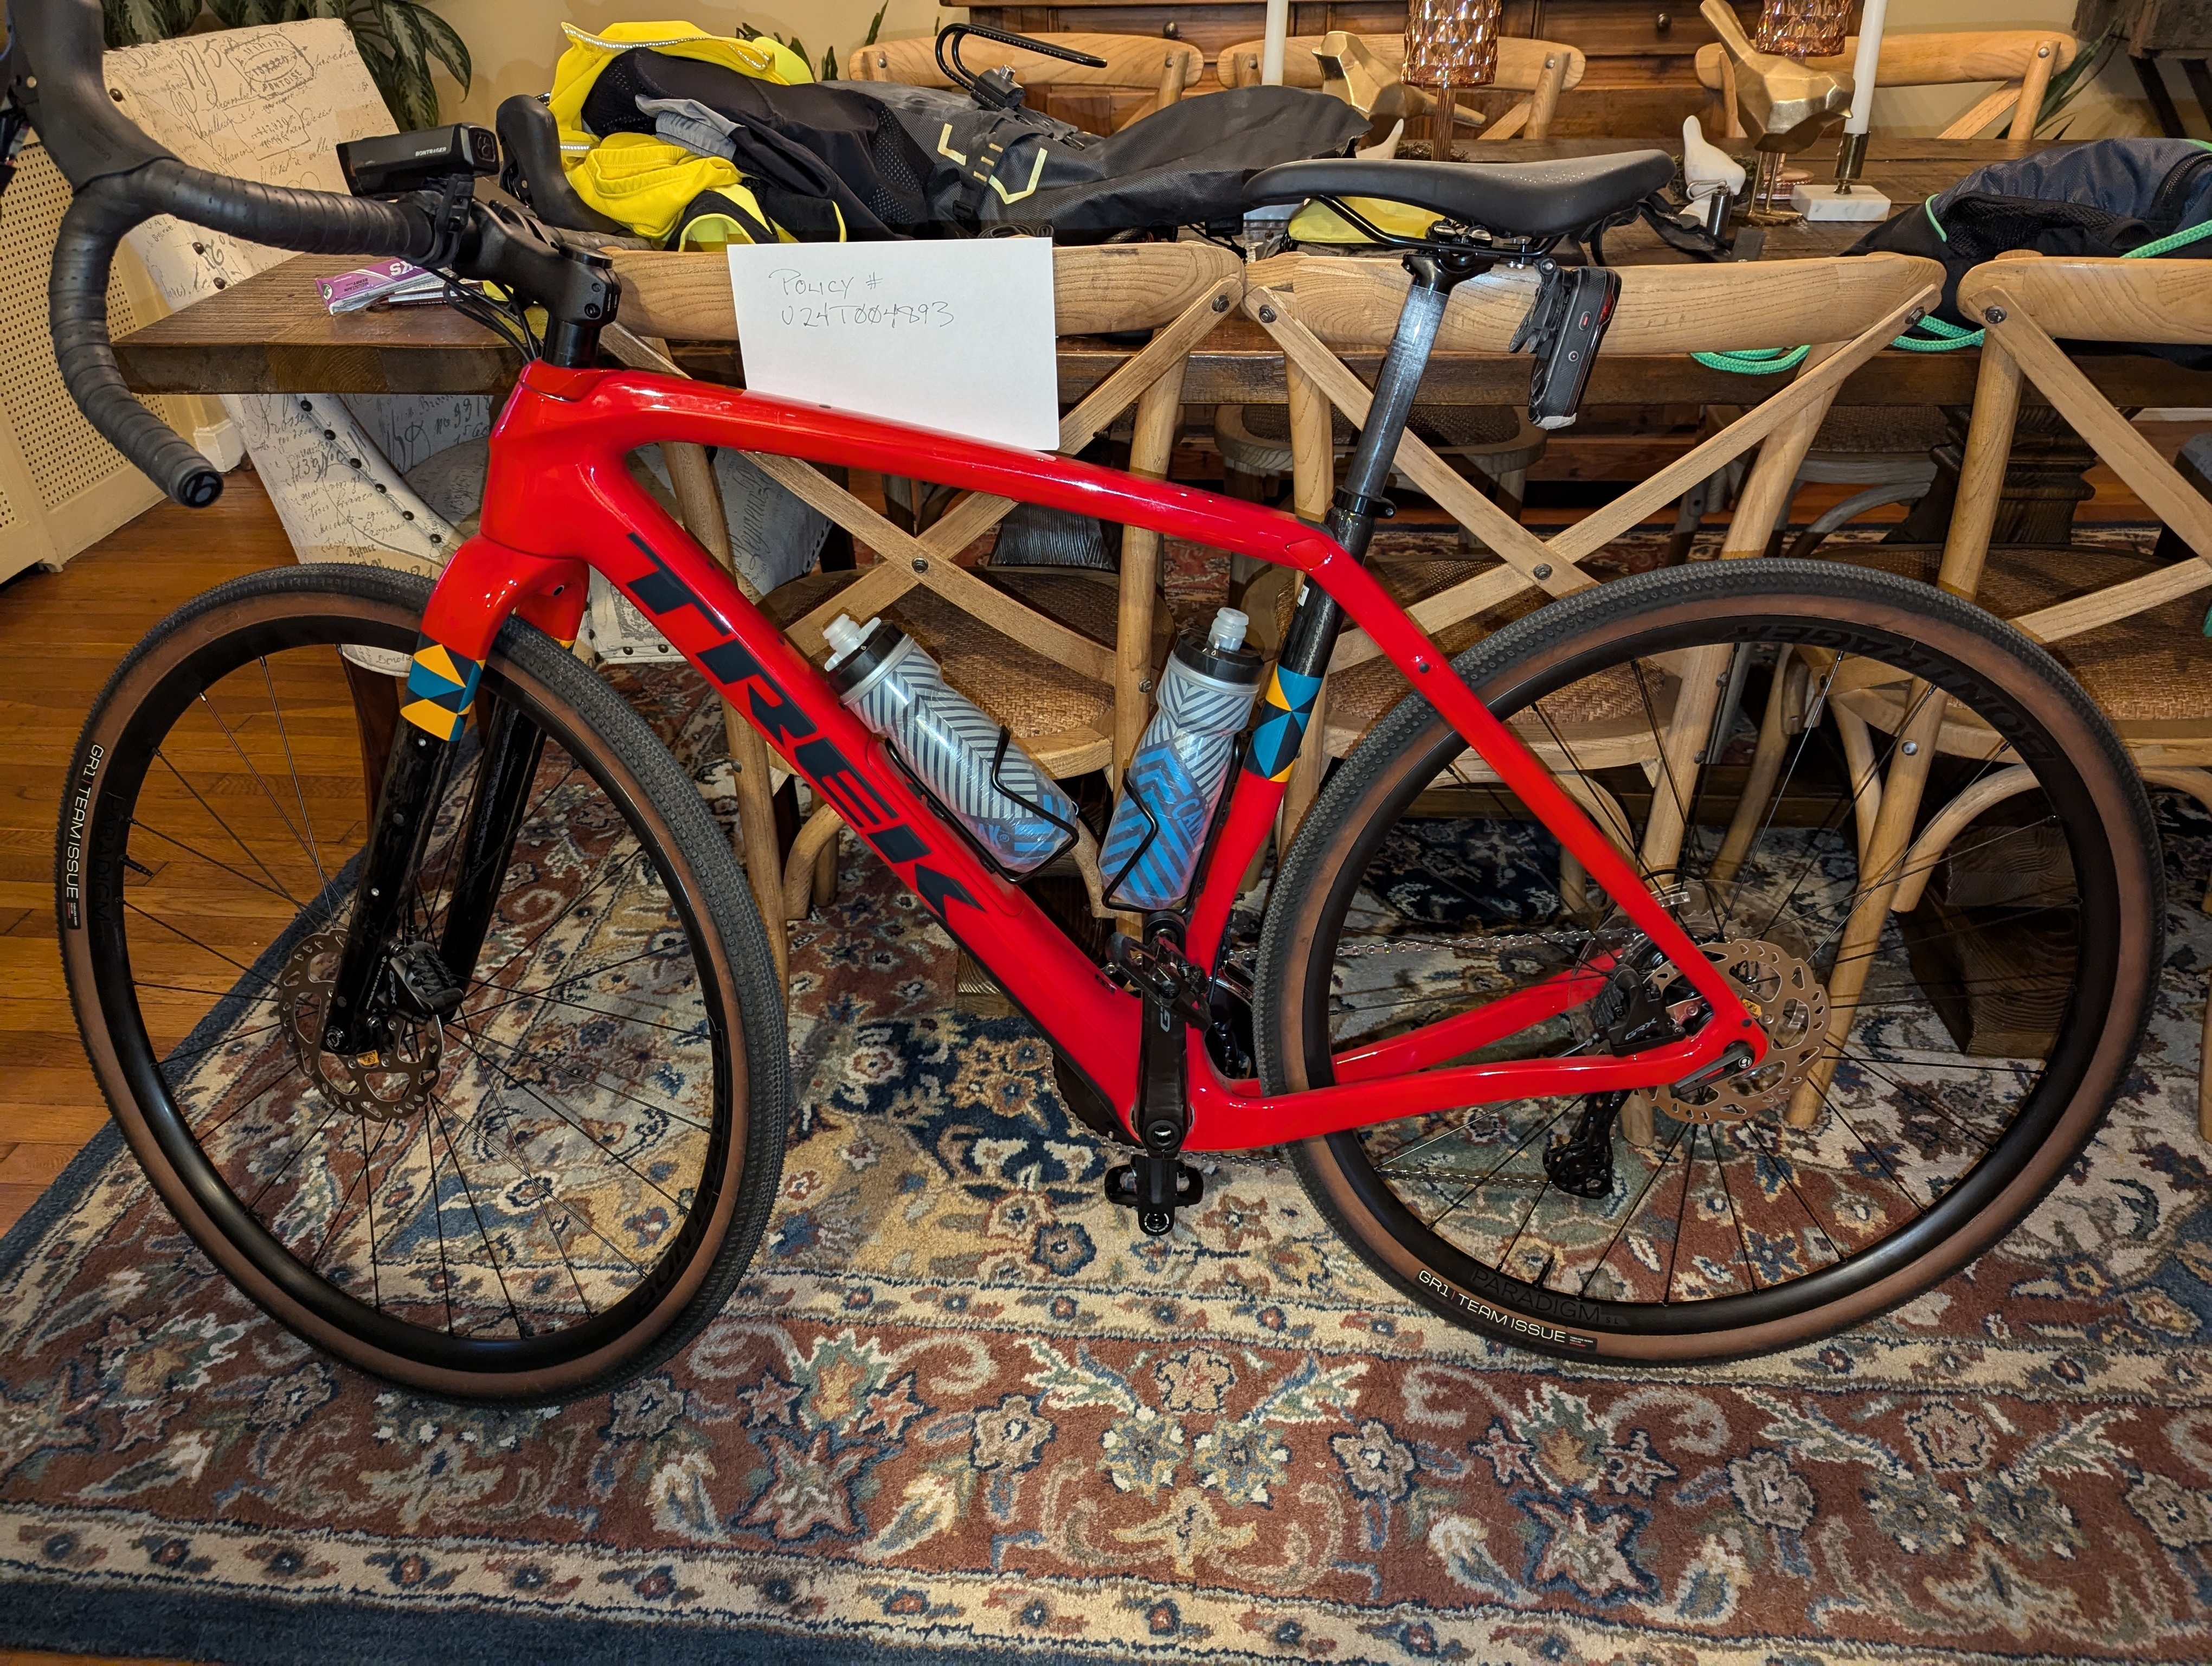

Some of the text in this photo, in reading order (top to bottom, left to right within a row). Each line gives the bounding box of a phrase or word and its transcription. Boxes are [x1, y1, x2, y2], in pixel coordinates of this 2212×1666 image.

[415, 146, 447, 157] BONTRAGER
[866, 272, 883, 290] #
[627, 532, 987, 925] TREK
[83, 744, 104, 777] GR1
[69, 787, 91, 840] TEAM
[66, 841, 80, 899] ISSUE
[389, 970, 397, 1005] GRX
[1624, 1017, 1658, 1040] GRX
[1419, 1270, 1449, 1298] GR1
[1458, 1294, 1508, 1326] TEAM
[1510, 1317, 1566, 1343] ISSUE
[1471, 1268, 1600, 1322] PARADIGM
